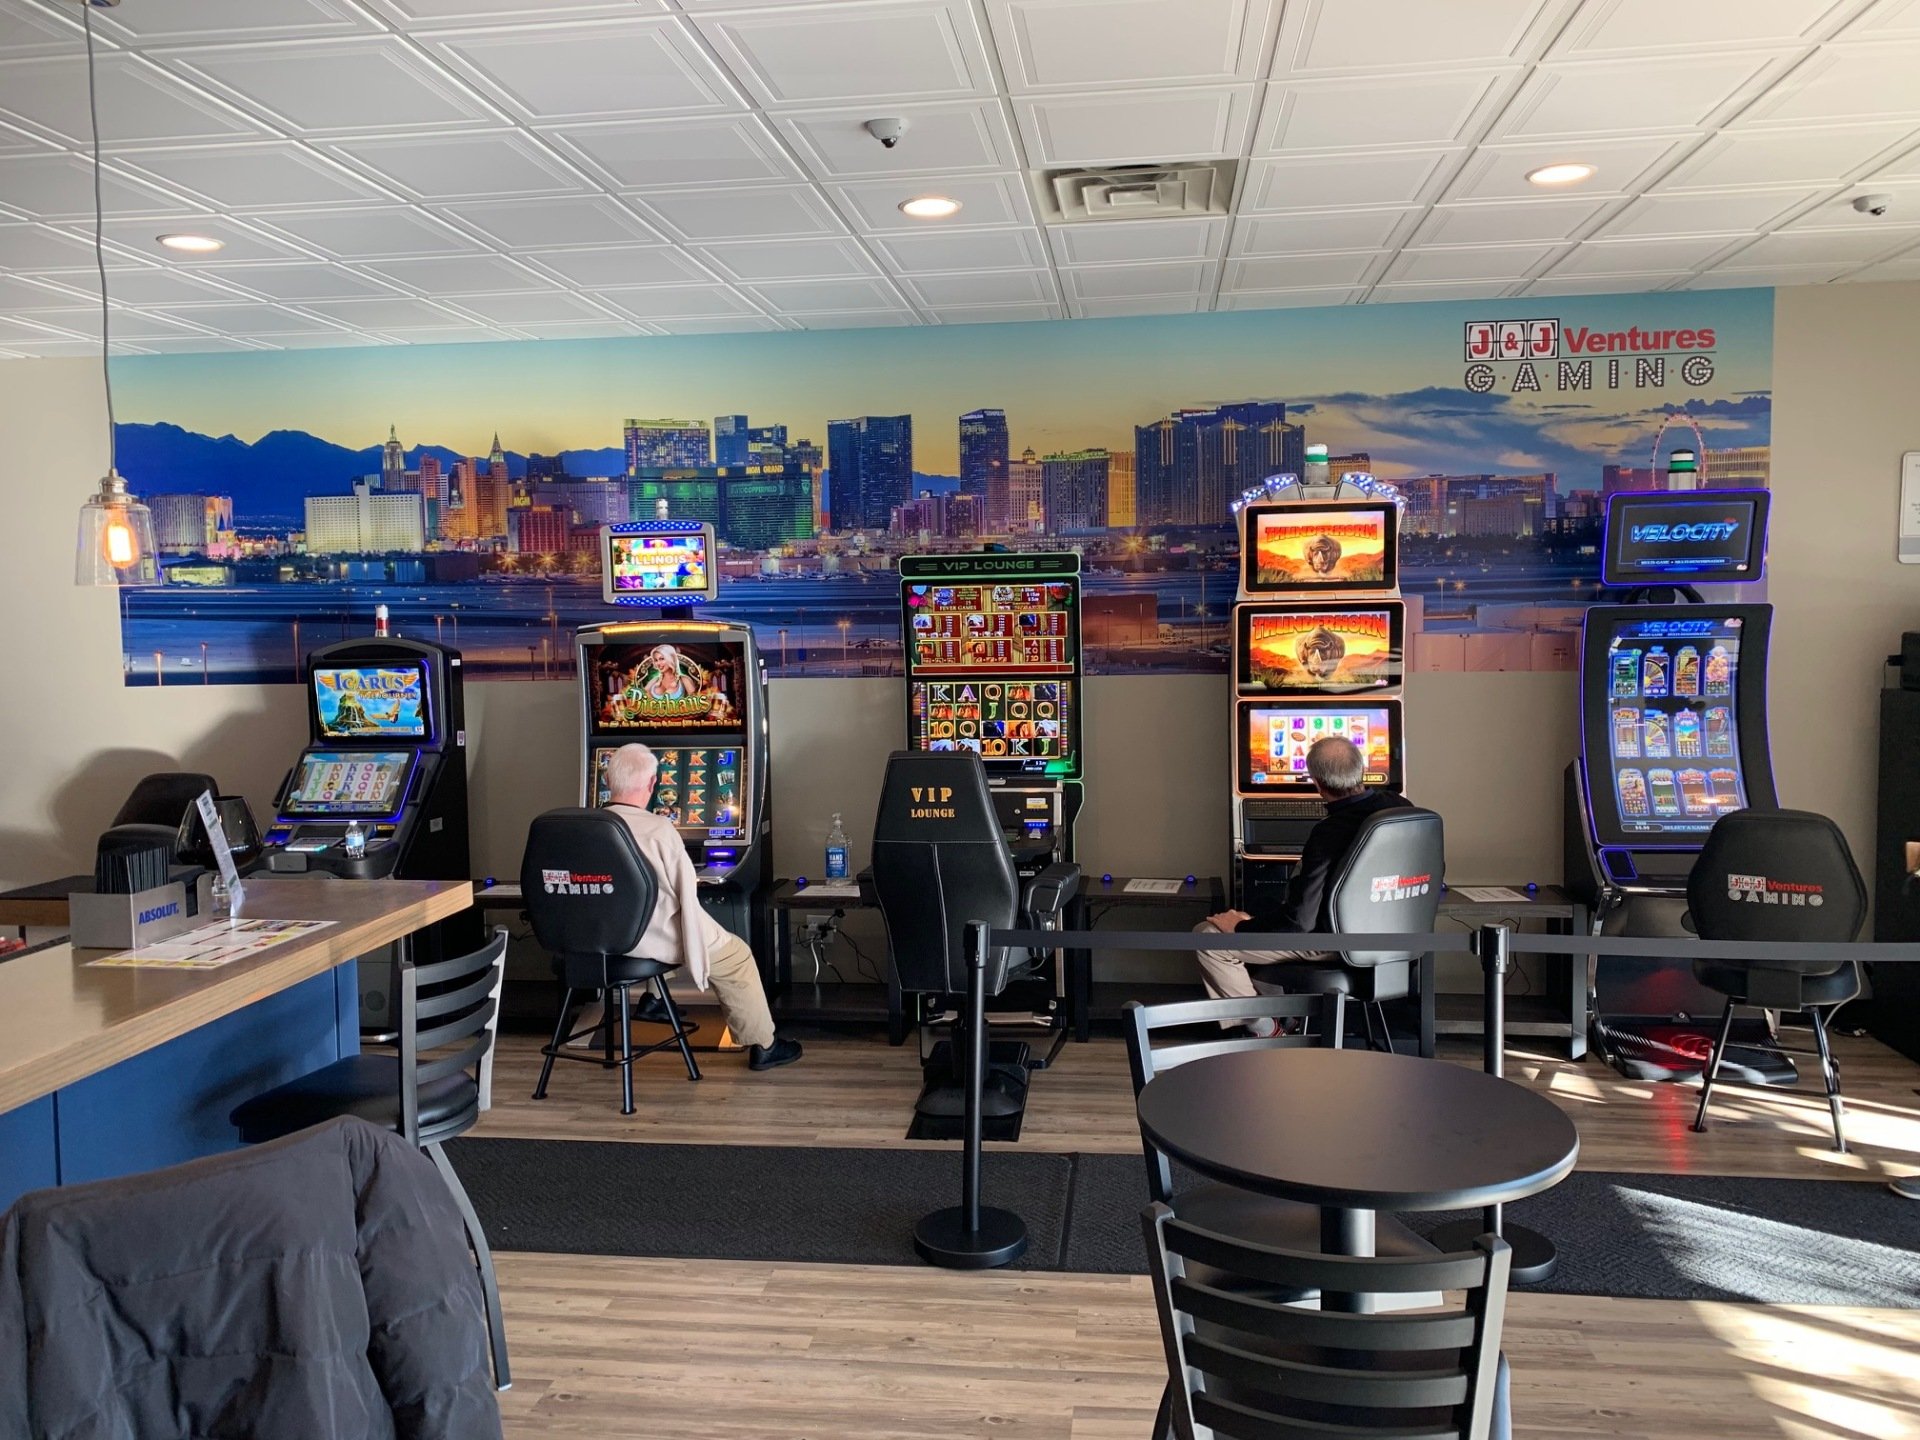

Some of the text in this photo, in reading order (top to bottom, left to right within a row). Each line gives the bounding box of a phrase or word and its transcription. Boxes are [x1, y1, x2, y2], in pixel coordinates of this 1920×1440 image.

[1469, 323, 1717, 358] J&J Ventures
[1265, 523, 1378, 543] THUNDERHORN
[1630, 522, 1739, 543] VELOCITY
[631, 554, 687, 565] ILLINOIS
[943, 560, 1035, 571] VIP LOUNGE
[1252, 613, 1388, 640] THUNDERHORN
[1642, 620, 1713, 633] VELOCITY
[333, 672, 404, 691] ICARUS
[932, 684, 1002, 702] K A Q
[625, 688, 712, 718] Bierhaus
[988, 701, 1055, 720] J Q Q
[930, 720, 977, 738] 10 Q
[1313, 717, 1324, 730] 9
[1333, 717, 1343, 729] 9
[1274, 731, 1285, 743] J
[982, 738, 1051, 756] 10 K J
[1274, 744, 1305, 757] J A
[689, 750, 736, 766] K J
[364, 763, 374, 772] Q
[361, 772, 371, 781] Q
[659, 770, 707, 785] K K
[358, 781, 368, 791] Q
[323, 791, 333, 801] Q
[687, 789, 706, 805] K
[911, 787, 953, 803] VIP
[686, 808, 732, 824] K J
[911, 808, 956, 818] LOUNGE
[571, 873, 613, 883] Ventures
[1399, 874, 1431, 888] Ventures
[1767, 880, 1823, 893] Ventures
